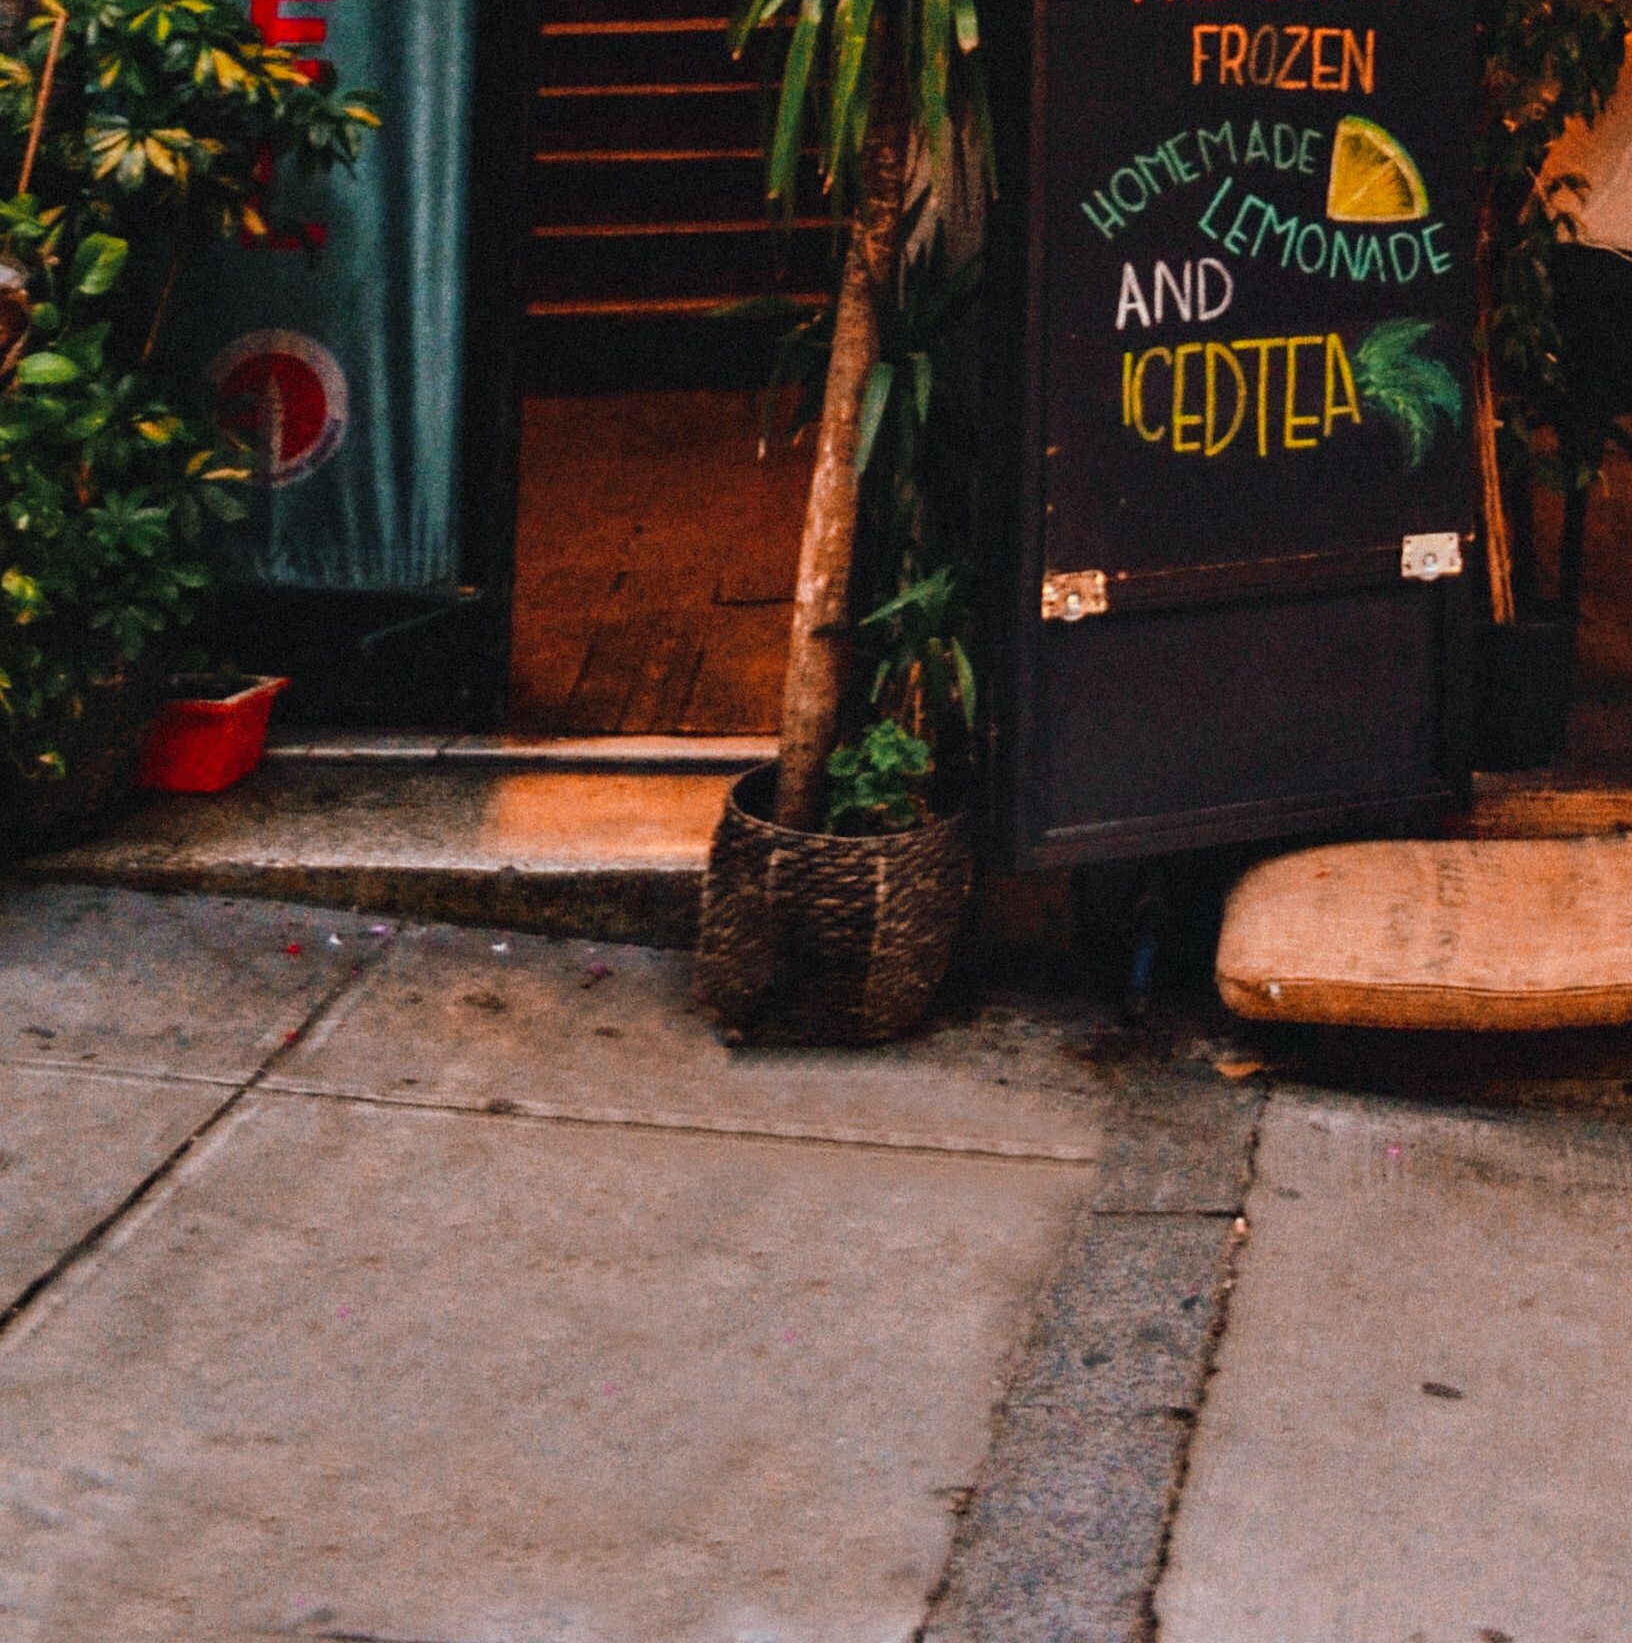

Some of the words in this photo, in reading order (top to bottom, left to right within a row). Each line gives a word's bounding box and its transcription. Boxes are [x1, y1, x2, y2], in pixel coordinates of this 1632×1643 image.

[1192, 23, 1376, 95] FROZEN
[1081, 120, 1325, 240] HOMEMADE
[1199, 176, 1454, 284] LEMONADE
[1115, 257, 1235, 330] AND
